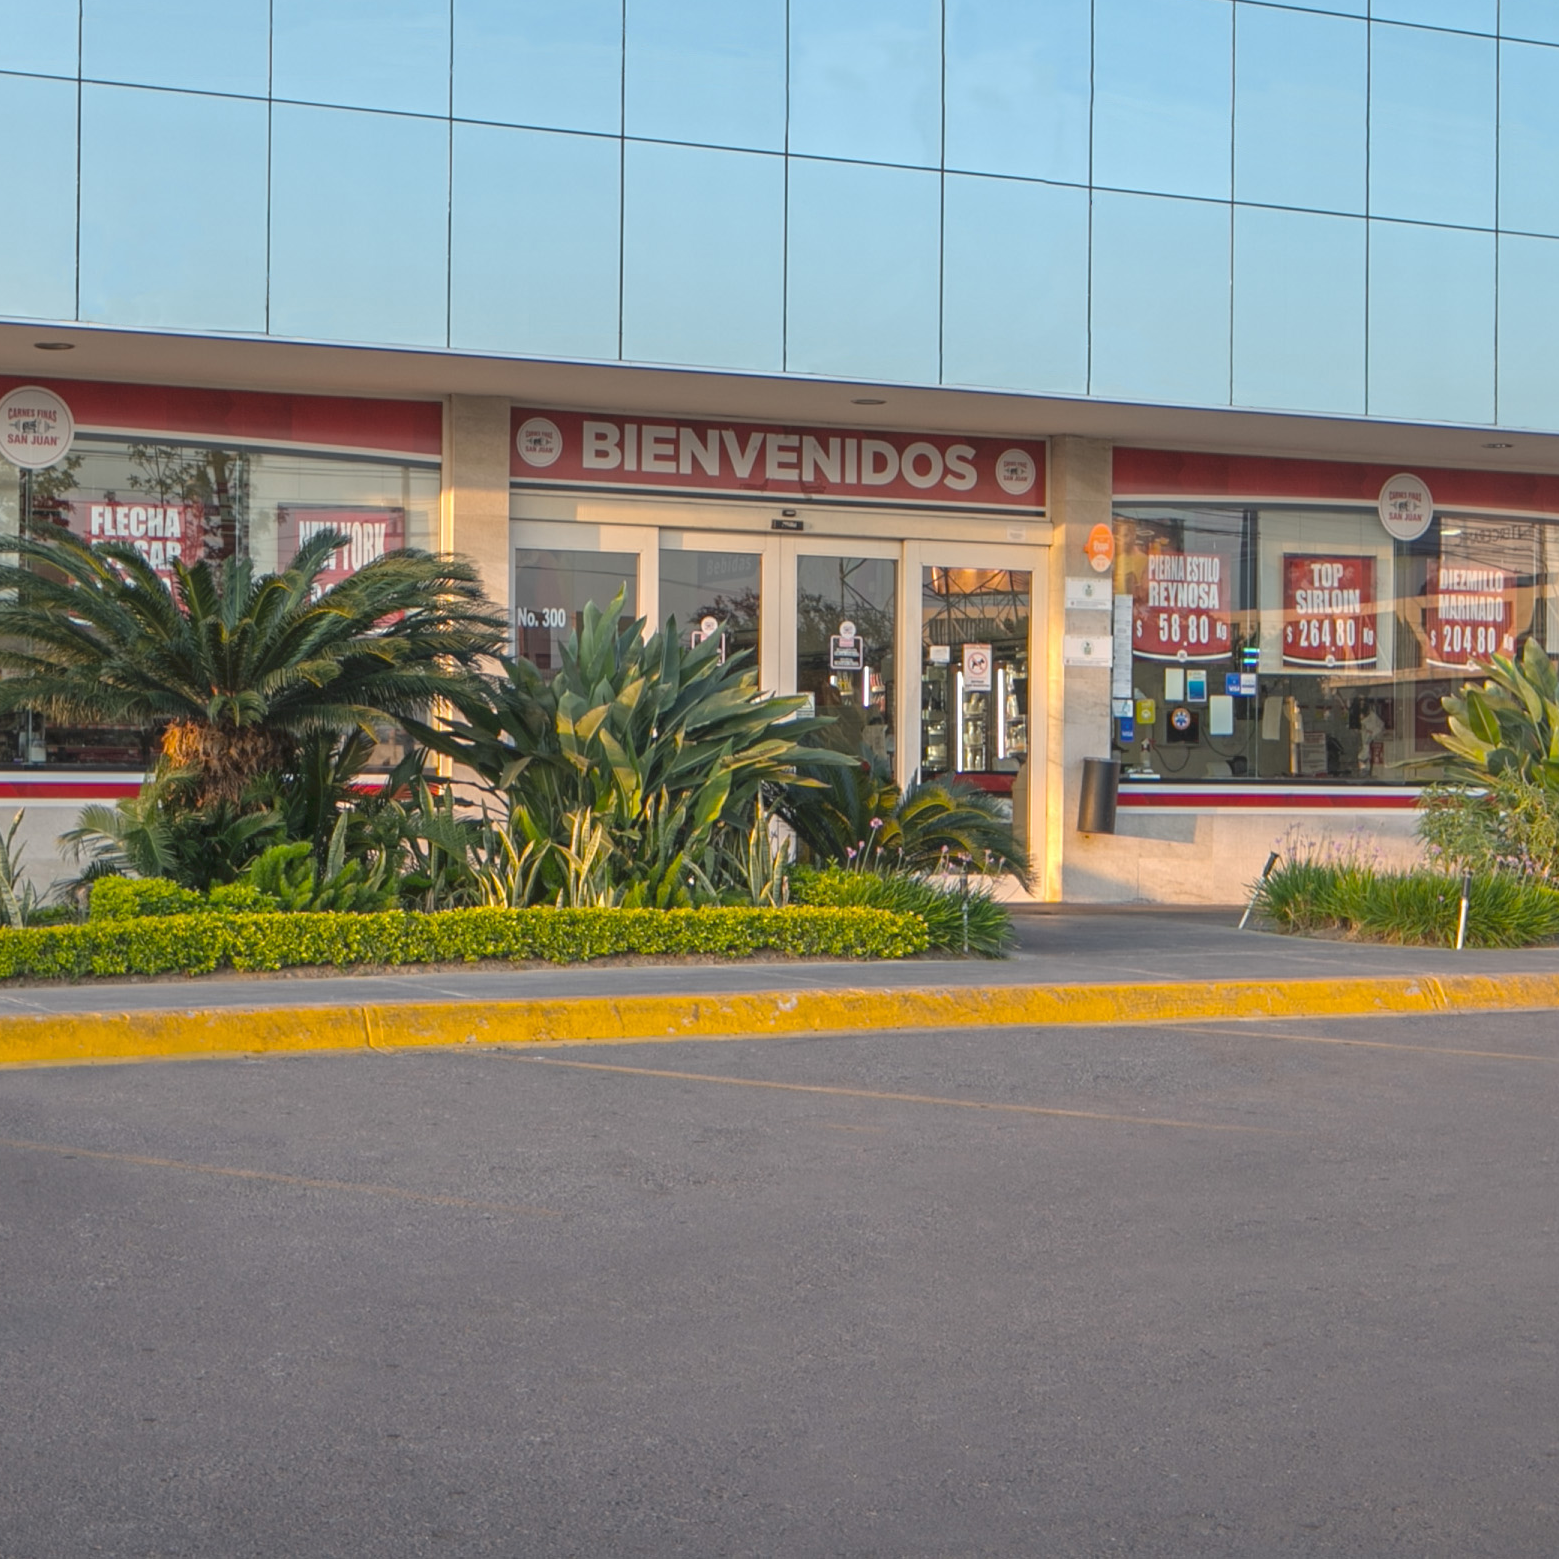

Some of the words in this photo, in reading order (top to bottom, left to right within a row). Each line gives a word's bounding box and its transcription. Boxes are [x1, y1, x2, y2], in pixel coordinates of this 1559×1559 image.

[8, 407, 35, 420] CARNES
[37, 409, 57, 423] FINAS
[7, 433, 28, 445] SAN
[31, 435, 58, 447] JUAN
[582, 420, 978, 491] BIENVENIDOS
[91, 505, 181, 538] FLECHA
[340, 520, 387, 572] YORK
[706, 554, 752, 575] Bebidas
[1148, 554, 1185, 581] PIERNA
[1186, 556, 1220, 583] ESTILO
[1311, 563, 1344, 588] TOP
[1439, 569, 1504, 593] DIEZMILLO
[1148, 581, 1219, 610] REYNOSA
[1295, 589, 1361, 614] SIRLOIN
[1438, 594, 1504, 622] MARINADO
[518, 607, 539, 627] No.
[542, 607, 566, 628] 300
